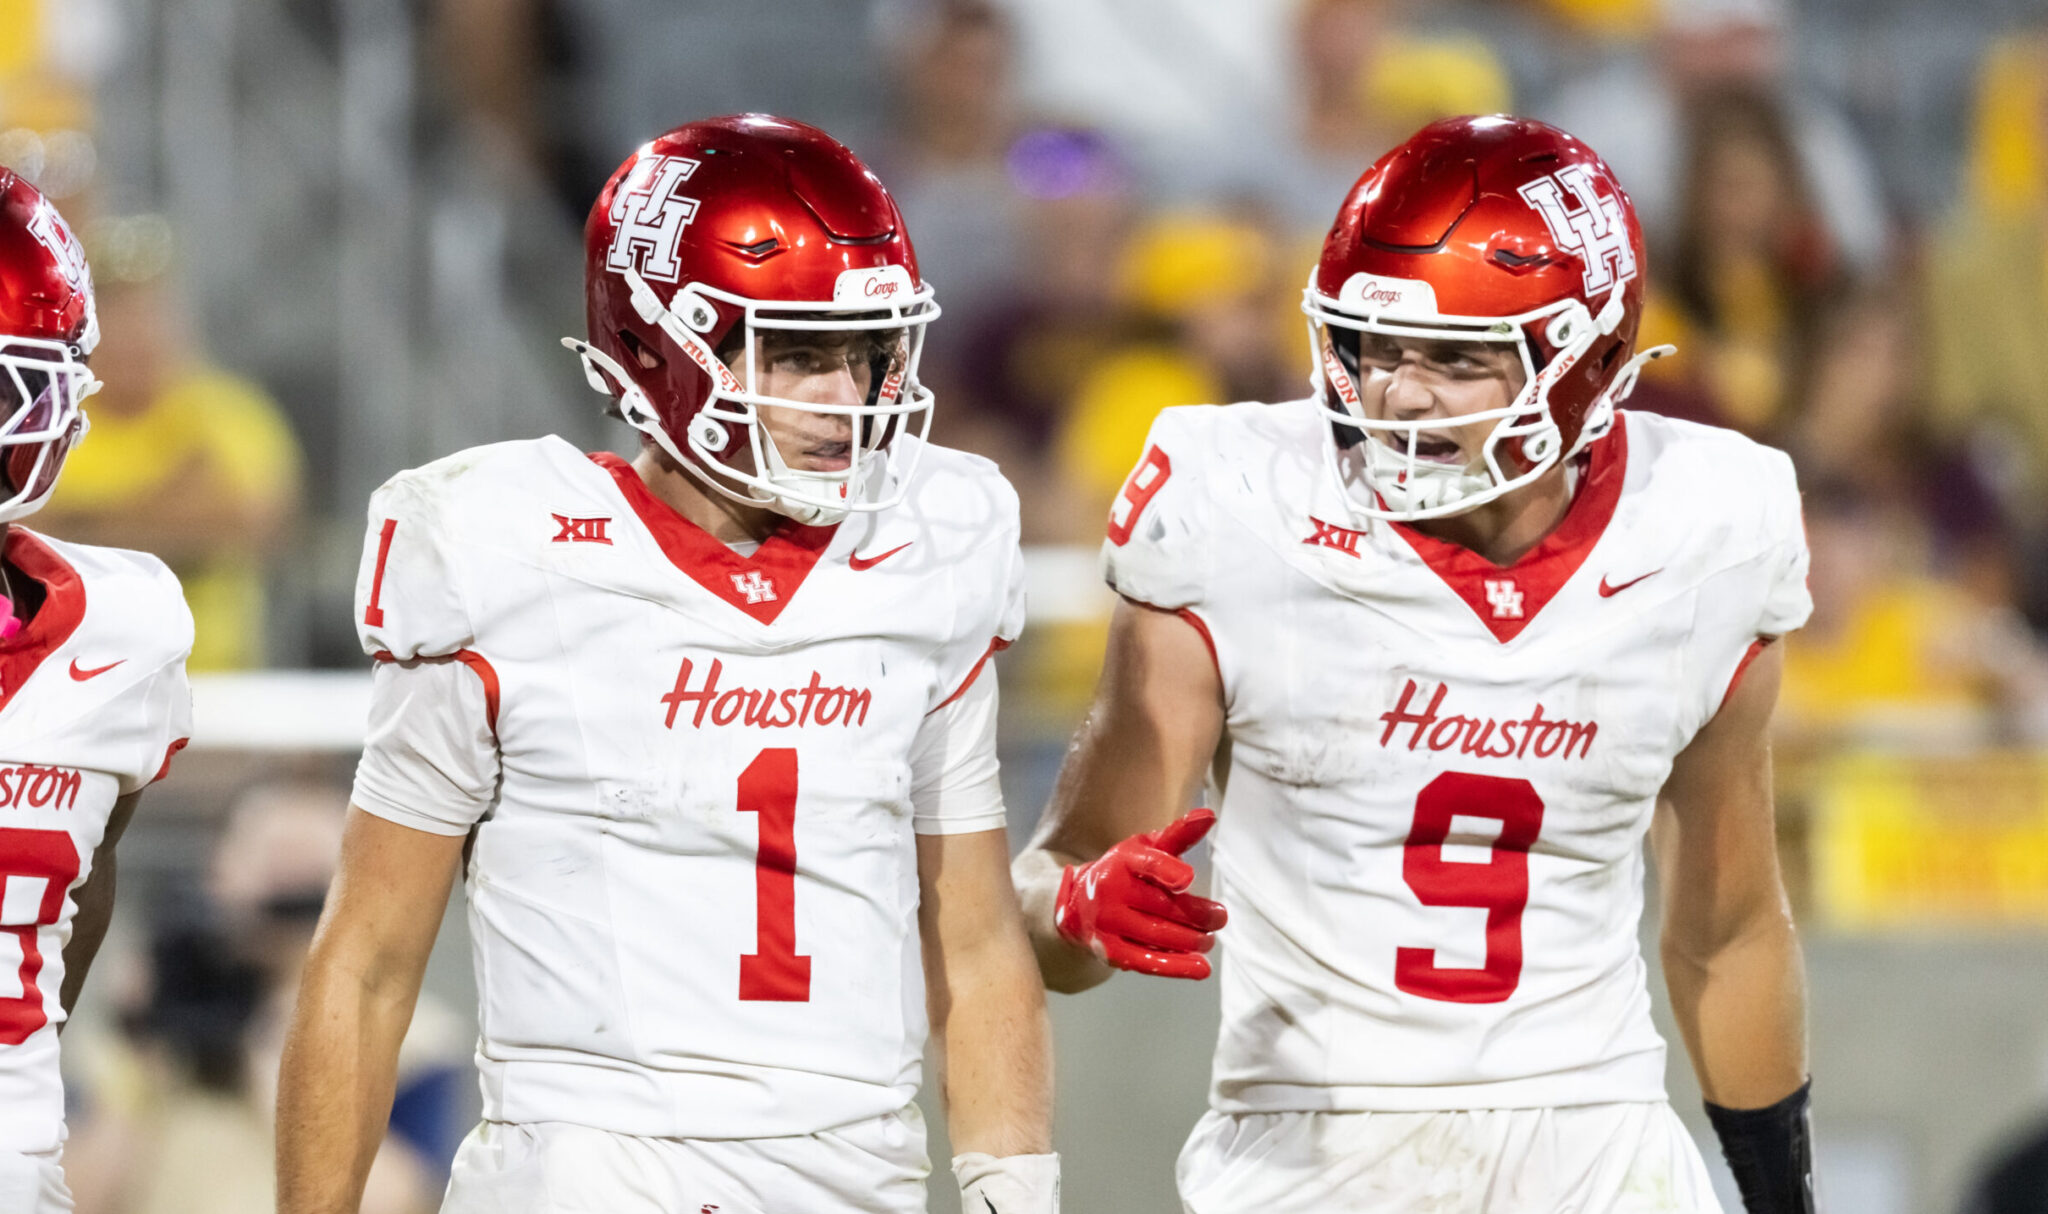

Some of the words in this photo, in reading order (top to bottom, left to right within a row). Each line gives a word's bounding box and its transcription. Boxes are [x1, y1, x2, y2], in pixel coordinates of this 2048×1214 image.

[1517, 163, 1637, 298] UH
[864, 276, 899, 300] Coogs
[1361, 281, 1402, 308] Coogs
[552, 513, 614, 545] XII
[1107, 443, 1172, 547] 9
[364, 518, 398, 628] 1
[1302, 515, 1367, 559] XII
[729, 571, 778, 605] UH
[1484, 579, 1524, 618] UH
[660, 656, 872, 730] Houston
[1379, 678, 1599, 760] Houston
[736, 747, 812, 1003] 1
[1394, 770, 1545, 1005] 9
